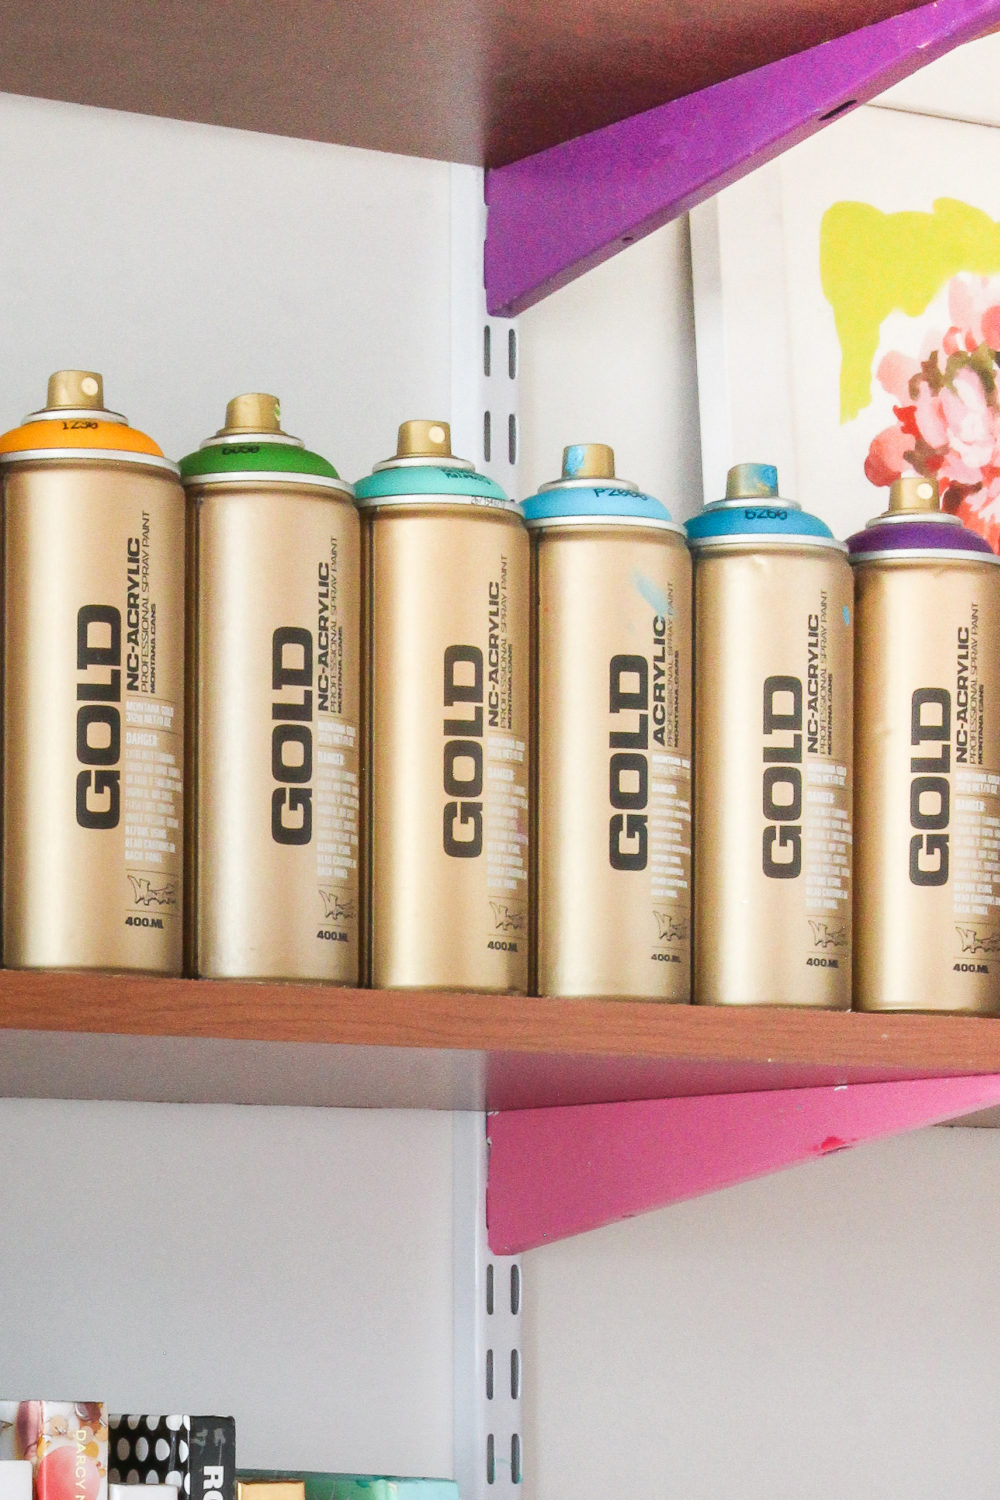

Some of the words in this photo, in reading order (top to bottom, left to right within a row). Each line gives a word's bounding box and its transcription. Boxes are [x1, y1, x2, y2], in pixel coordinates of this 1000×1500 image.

[142, 511, 150, 547] PAINT
[127, 537, 139, 691] NC-ACRYLIC
[141, 598, 149, 693] PROFESSIONAL
[318, 562, 329, 711] NC-ACRYLIC
[488, 581, 499, 727] NC-ACRYLIC
[653, 615, 666, 747] ACRYLIC
[807, 614, 819, 753] NC-ACRYLIC
[75, 604, 121, 830] GOLD
[272, 626, 313, 846] GOLD
[442, 644, 484, 859] GOLD
[609, 654, 649, 872] GOLD
[956, 626, 969, 763] NC-ACRYLIC
[762, 676, 803, 880] GOLD
[909, 687, 952, 888] GOLD
[125, 916, 164, 930] 400.ML
[75, 1429, 86, 1491] DARCY
